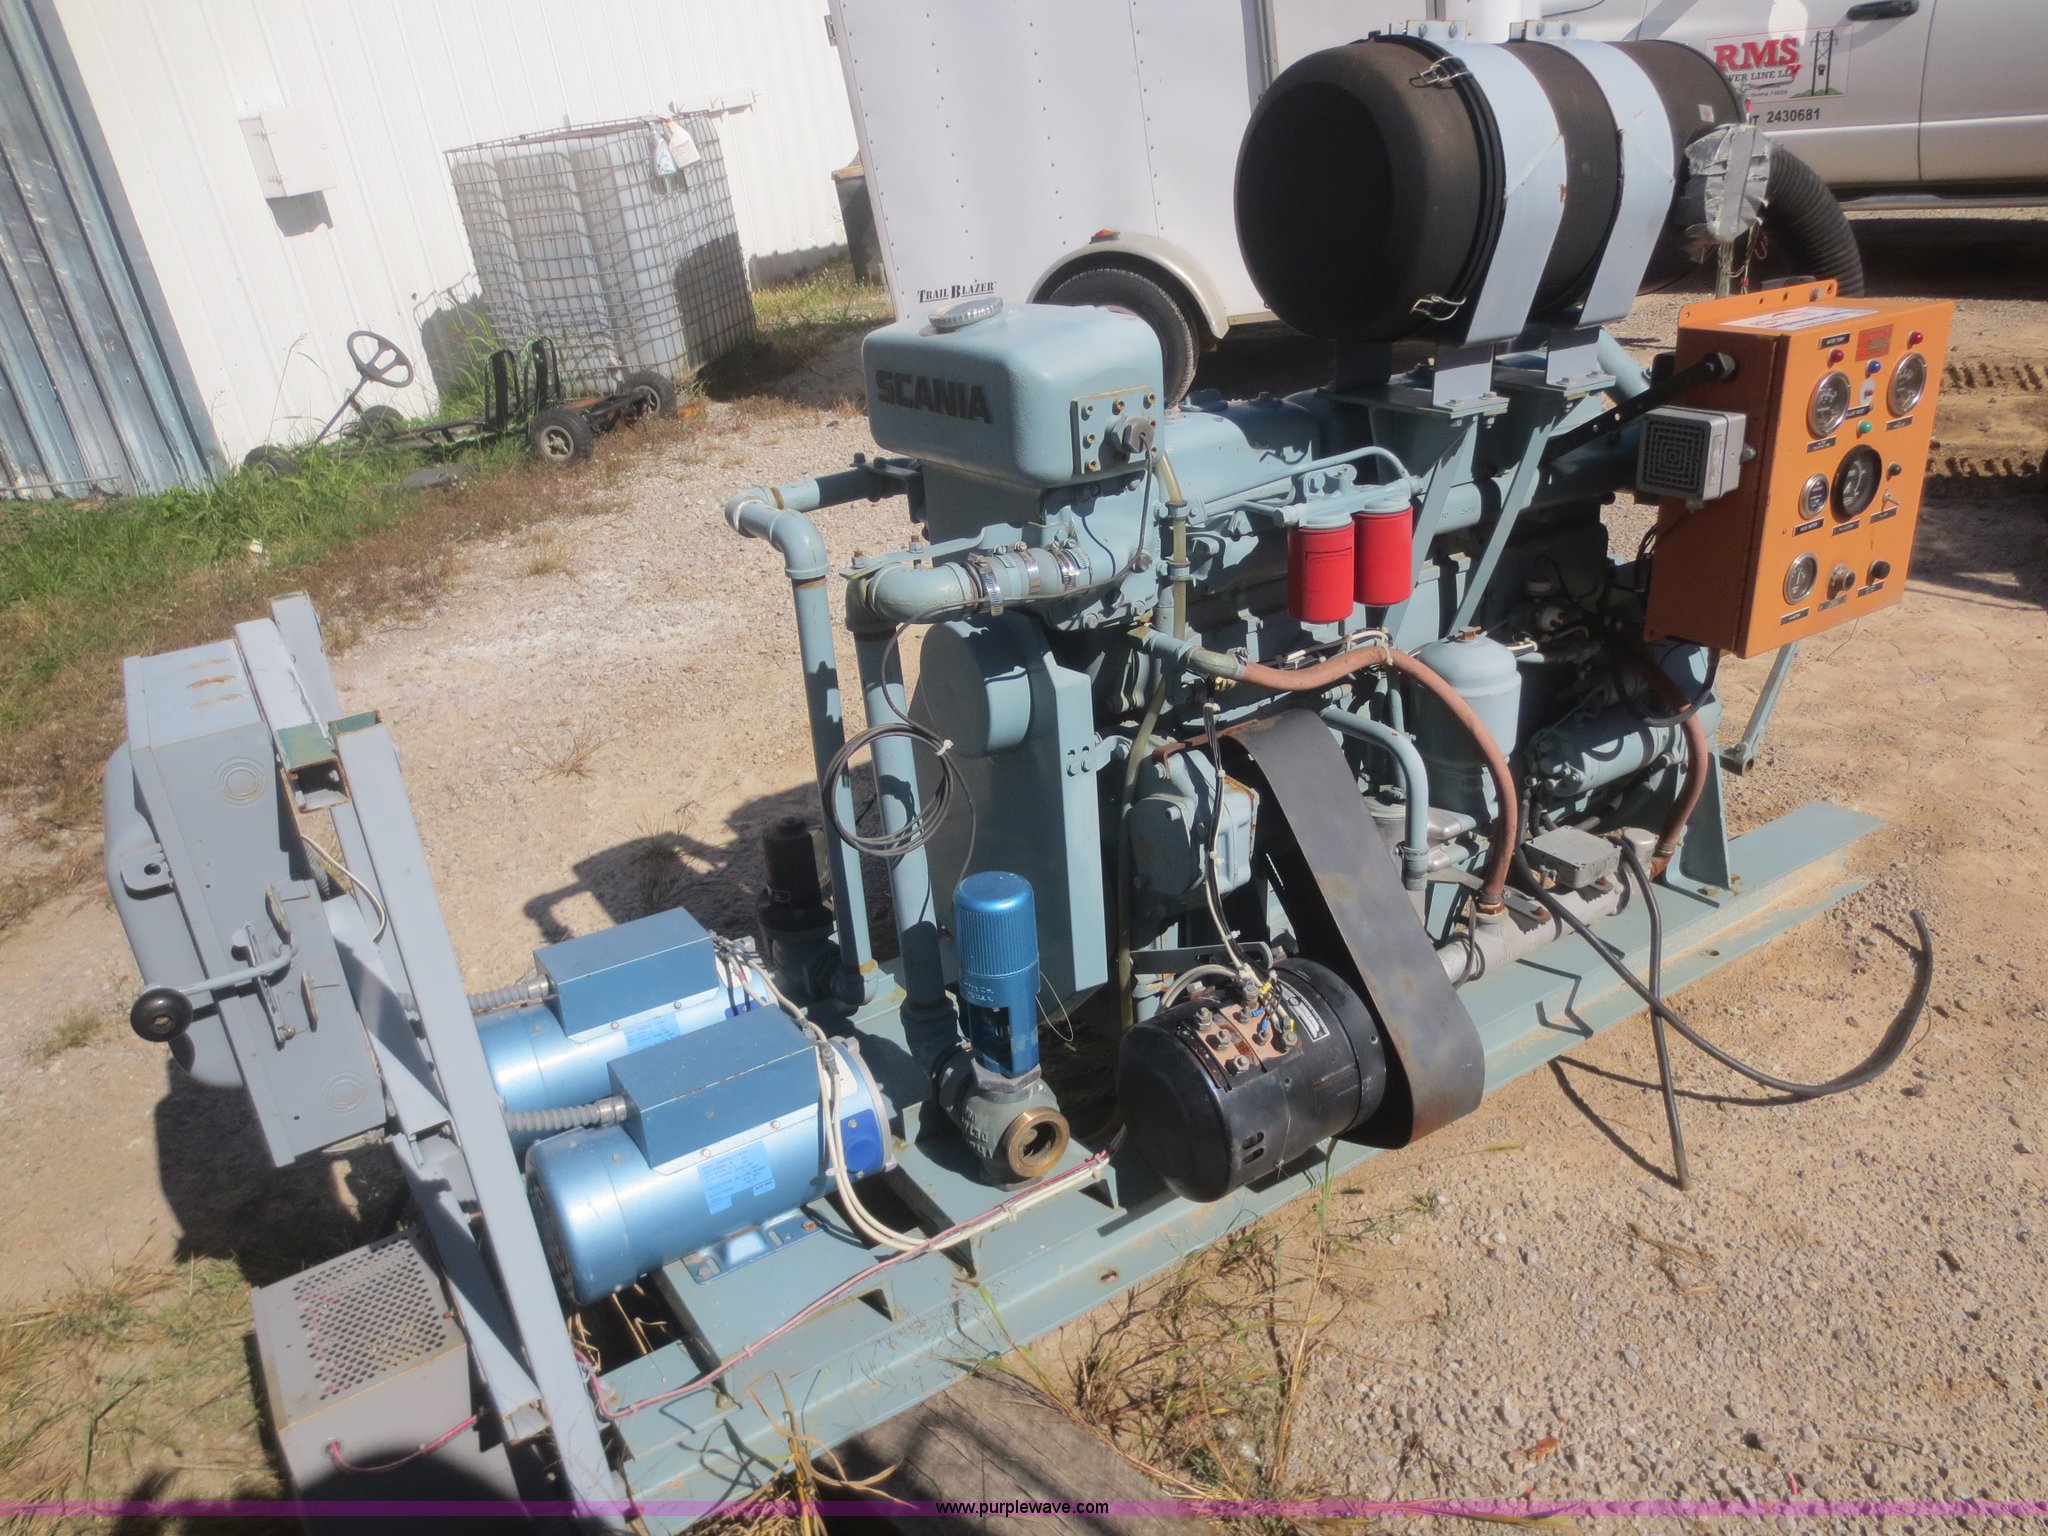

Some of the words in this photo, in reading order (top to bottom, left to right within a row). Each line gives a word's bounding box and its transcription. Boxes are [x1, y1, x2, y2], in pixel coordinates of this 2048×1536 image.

[1713, 37, 1799, 71] RMS
[1727, 73, 1748, 82] WER
[1751, 71, 1775, 80] LINE
[1778, 69, 1793, 78] LL
[1767, 108, 1820, 124] 2430681
[917, 288, 949, 303] TRAIL
[876, 369, 992, 425] SCANIA
